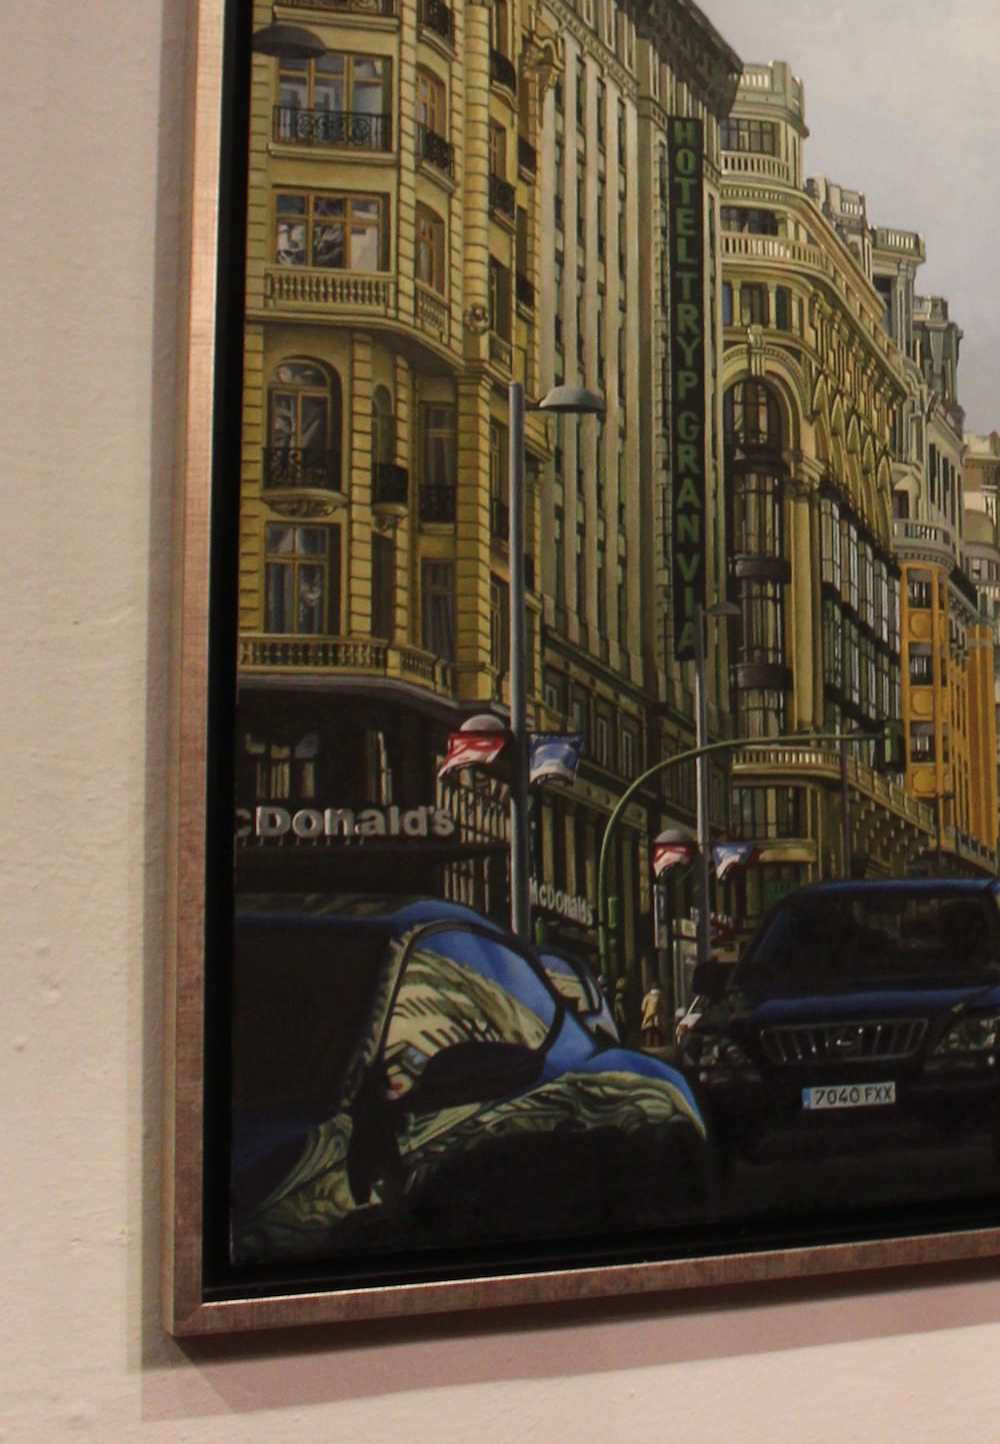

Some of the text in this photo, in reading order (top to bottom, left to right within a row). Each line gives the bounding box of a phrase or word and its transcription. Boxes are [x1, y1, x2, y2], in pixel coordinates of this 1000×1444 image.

[673, 120, 702, 654] HOTEL TRYP GRAN VIA
[815, 1084, 893, 1106] 7040 FXX
